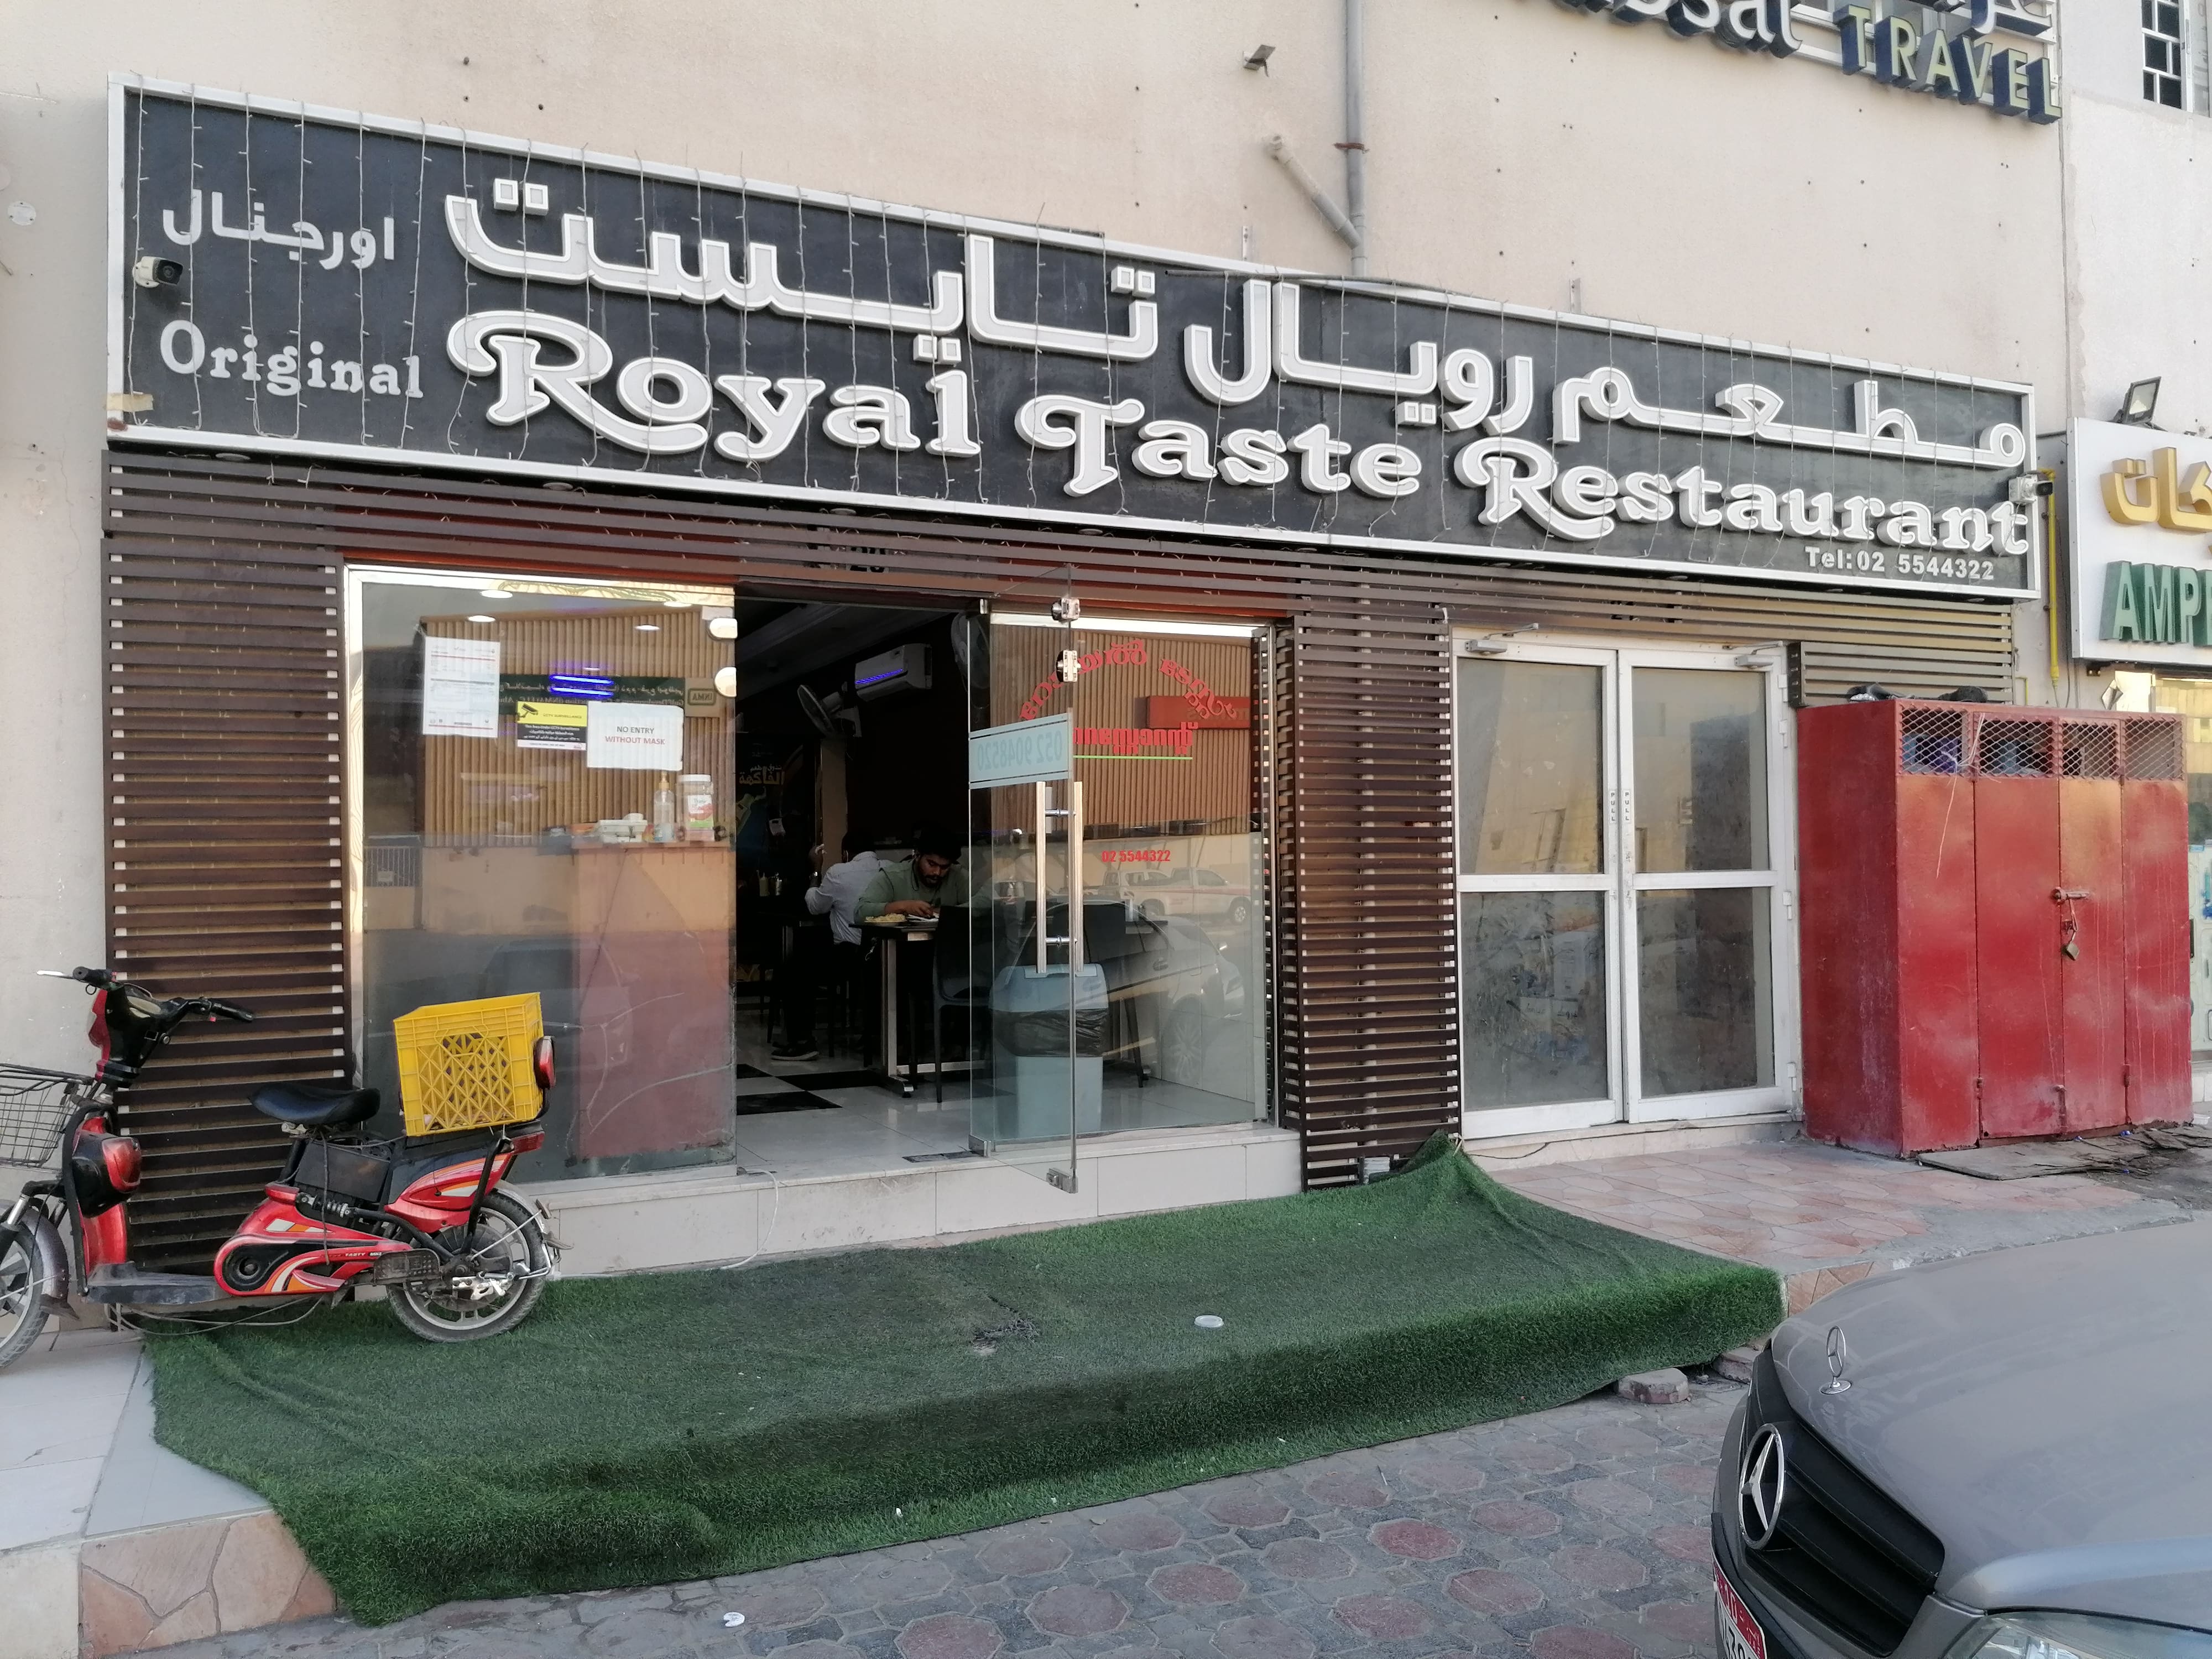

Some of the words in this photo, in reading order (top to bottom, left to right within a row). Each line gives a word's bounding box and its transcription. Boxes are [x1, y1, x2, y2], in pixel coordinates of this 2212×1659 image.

[1833, 4, 2062, 124] TRAVEL
[162, 188, 395, 270] اورجنال
[445, 178, 1159, 366] تايست
[159, 319, 424, 399] Original
[1184, 278, 1533, 436] رويال
[446, 310, 981, 463] Royal
[1014, 394, 1422, 498] Taste
[1453, 436, 2030, 555] Restaurant
[1553, 367, 2026, 468] مطعم
[1898, 554, 1995, 580] 5544322
[1101, 850, 1117, 863] 02
[1119, 849, 1171, 863] 5544322
